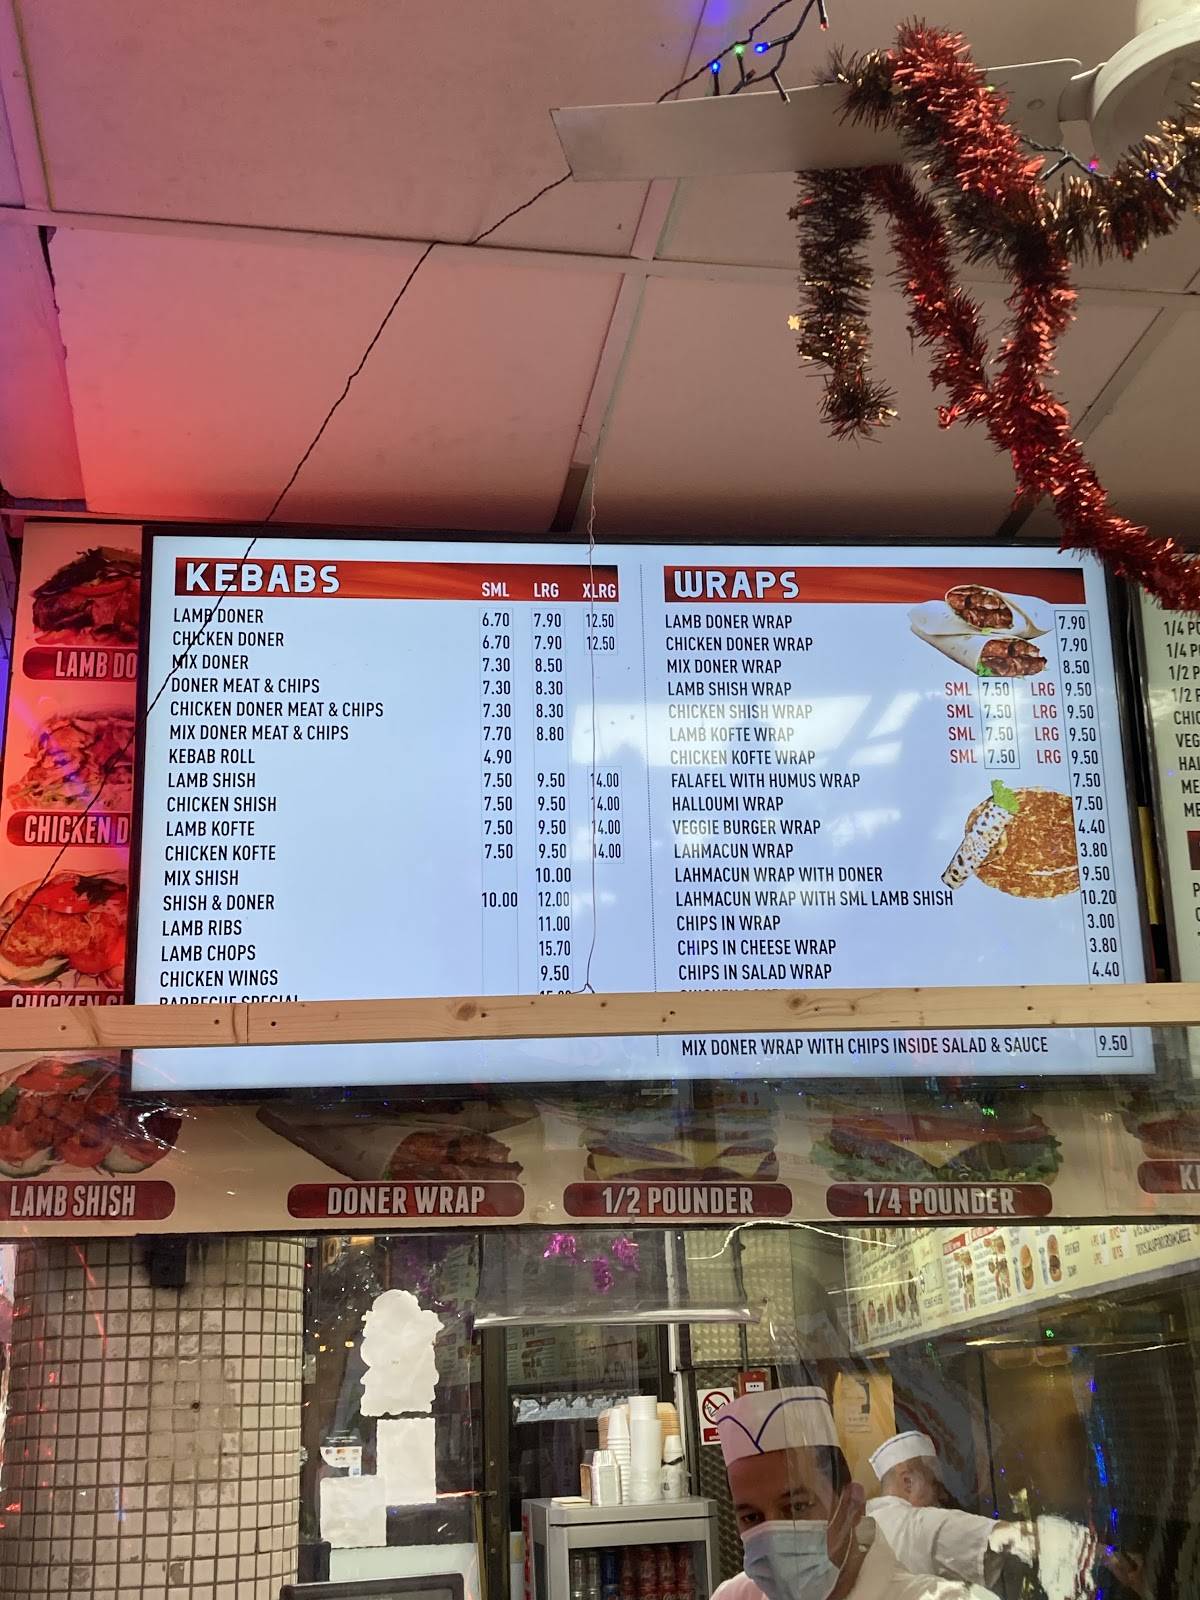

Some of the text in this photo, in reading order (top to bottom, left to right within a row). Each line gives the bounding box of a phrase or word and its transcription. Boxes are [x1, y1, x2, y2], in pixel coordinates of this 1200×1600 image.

[184, 561, 342, 594] KEBABS
[673, 569, 800, 600] WRAPS
[480, 581, 617, 600] SML LRG XLRG
[173, 607, 264, 625] LAMB DONER
[482, 611, 562, 628] 6.70 7.90
[665, 614, 793, 630] LAMB DONER WRAP
[1058, 615, 1086, 631] 7.90
[1163, 619, 1185, 637] 1/4
[172, 629, 284, 648] CHICKEN DONER
[482, 634, 562, 651] 6.70 7.90
[665, 636, 813, 652] CHICKEN DONER WRAP
[1060, 637, 1088, 653] 7.90
[1166, 641, 1188, 659] 1/4
[55, 650, 108, 678] LAMB
[171, 653, 249, 671] MIX DONER
[482, 657, 563, 673] 7.30 8.50
[666, 658, 782, 674] MIX DONER WRAP
[1062, 659, 1090, 675] 8.50
[1168, 664, 1190, 681] 1/2
[170, 677, 320, 694] DONER MEAT & CHIPS
[482, 679, 563, 696] 7.30 8.30
[667, 681, 792, 697] LAMB SHISH WRAP
[170, 699, 384, 717] CHICKEN DONER MEAT & CHIPS
[482, 702, 564, 719] 7.30 8.30
[169, 724, 349, 741] MIX DONER MEAT & CHIPS
[483, 725, 565, 742] 7.70 8.80
[168, 748, 256, 764] KEBAB ROLL
[483, 748, 512, 765] 4.90
[671, 749, 816, 766] CHICKEN KOFTE WRAP
[168, 772, 256, 789] LAMB SHISH
[671, 772, 861, 789] FALAFEL WITH HUMUS WRAP
[1072, 772, 1101, 788] 7.50
[166, 796, 277, 813] CHICKEN SHISH
[672, 795, 784, 812] HALLOUMI WRAP
[1075, 795, 1104, 811] 7.50
[23, 814, 130, 844] CHICKEN D
[166, 820, 255, 837] LAMB KOFTE
[672, 819, 821, 835] VEGGIE BURGER WRAP
[1077, 818, 1106, 835] 4.40
[165, 844, 276, 862] CHICKEN KOFTE
[674, 842, 794, 859] LAHMACUN WRAP
[1079, 842, 1108, 858] 3.80
[164, 868, 239, 887] MIX SHISH
[535, 867, 572, 883] 10.00
[675, 866, 884, 883] LAHMACUN WRAP WITH DONER
[1082, 865, 1111, 881] 9.50
[163, 894, 275, 912] SHISH & DONER
[481, 890, 570, 908] 10.00 12.00
[675, 890, 954, 907] LAHMACUN WRAP WITH SML LAMB SHISH
[1080, 889, 1118, 905] 10.20
[162, 919, 242, 937] LAMB RIBS
[538, 915, 571, 932] 11.00
[676, 914, 781, 932] CHIPS IN WRAP
[1087, 913, 1115, 929] 3.00
[161, 944, 256, 962] LAMB CHOPS
[538, 939, 571, 957] 15.70
[677, 938, 837, 956] CHIPS IN CHEESE WRAP
[1089, 937, 1118, 953] 3.80
[540, 964, 570, 982] 9.50
[678, 963, 832, 981] CHIPS IN SALAD WRAP
[1092, 961, 1120, 977] 4.40
[160, 969, 279, 988] CHICKEN WINGS
[681, 1036, 1049, 1056] MIX DONER WRAP WITH CHIPS INSIDE SALAD & SAUCE
[1098, 1034, 1128, 1051] 9.50
[9, 1184, 136, 1217] LAMB SHISH
[327, 1185, 486, 1216] DONER WRAP
[602, 1186, 754, 1215] 1/2 POUNDER
[862, 1186, 1016, 1215] 1/4 POUNDER
